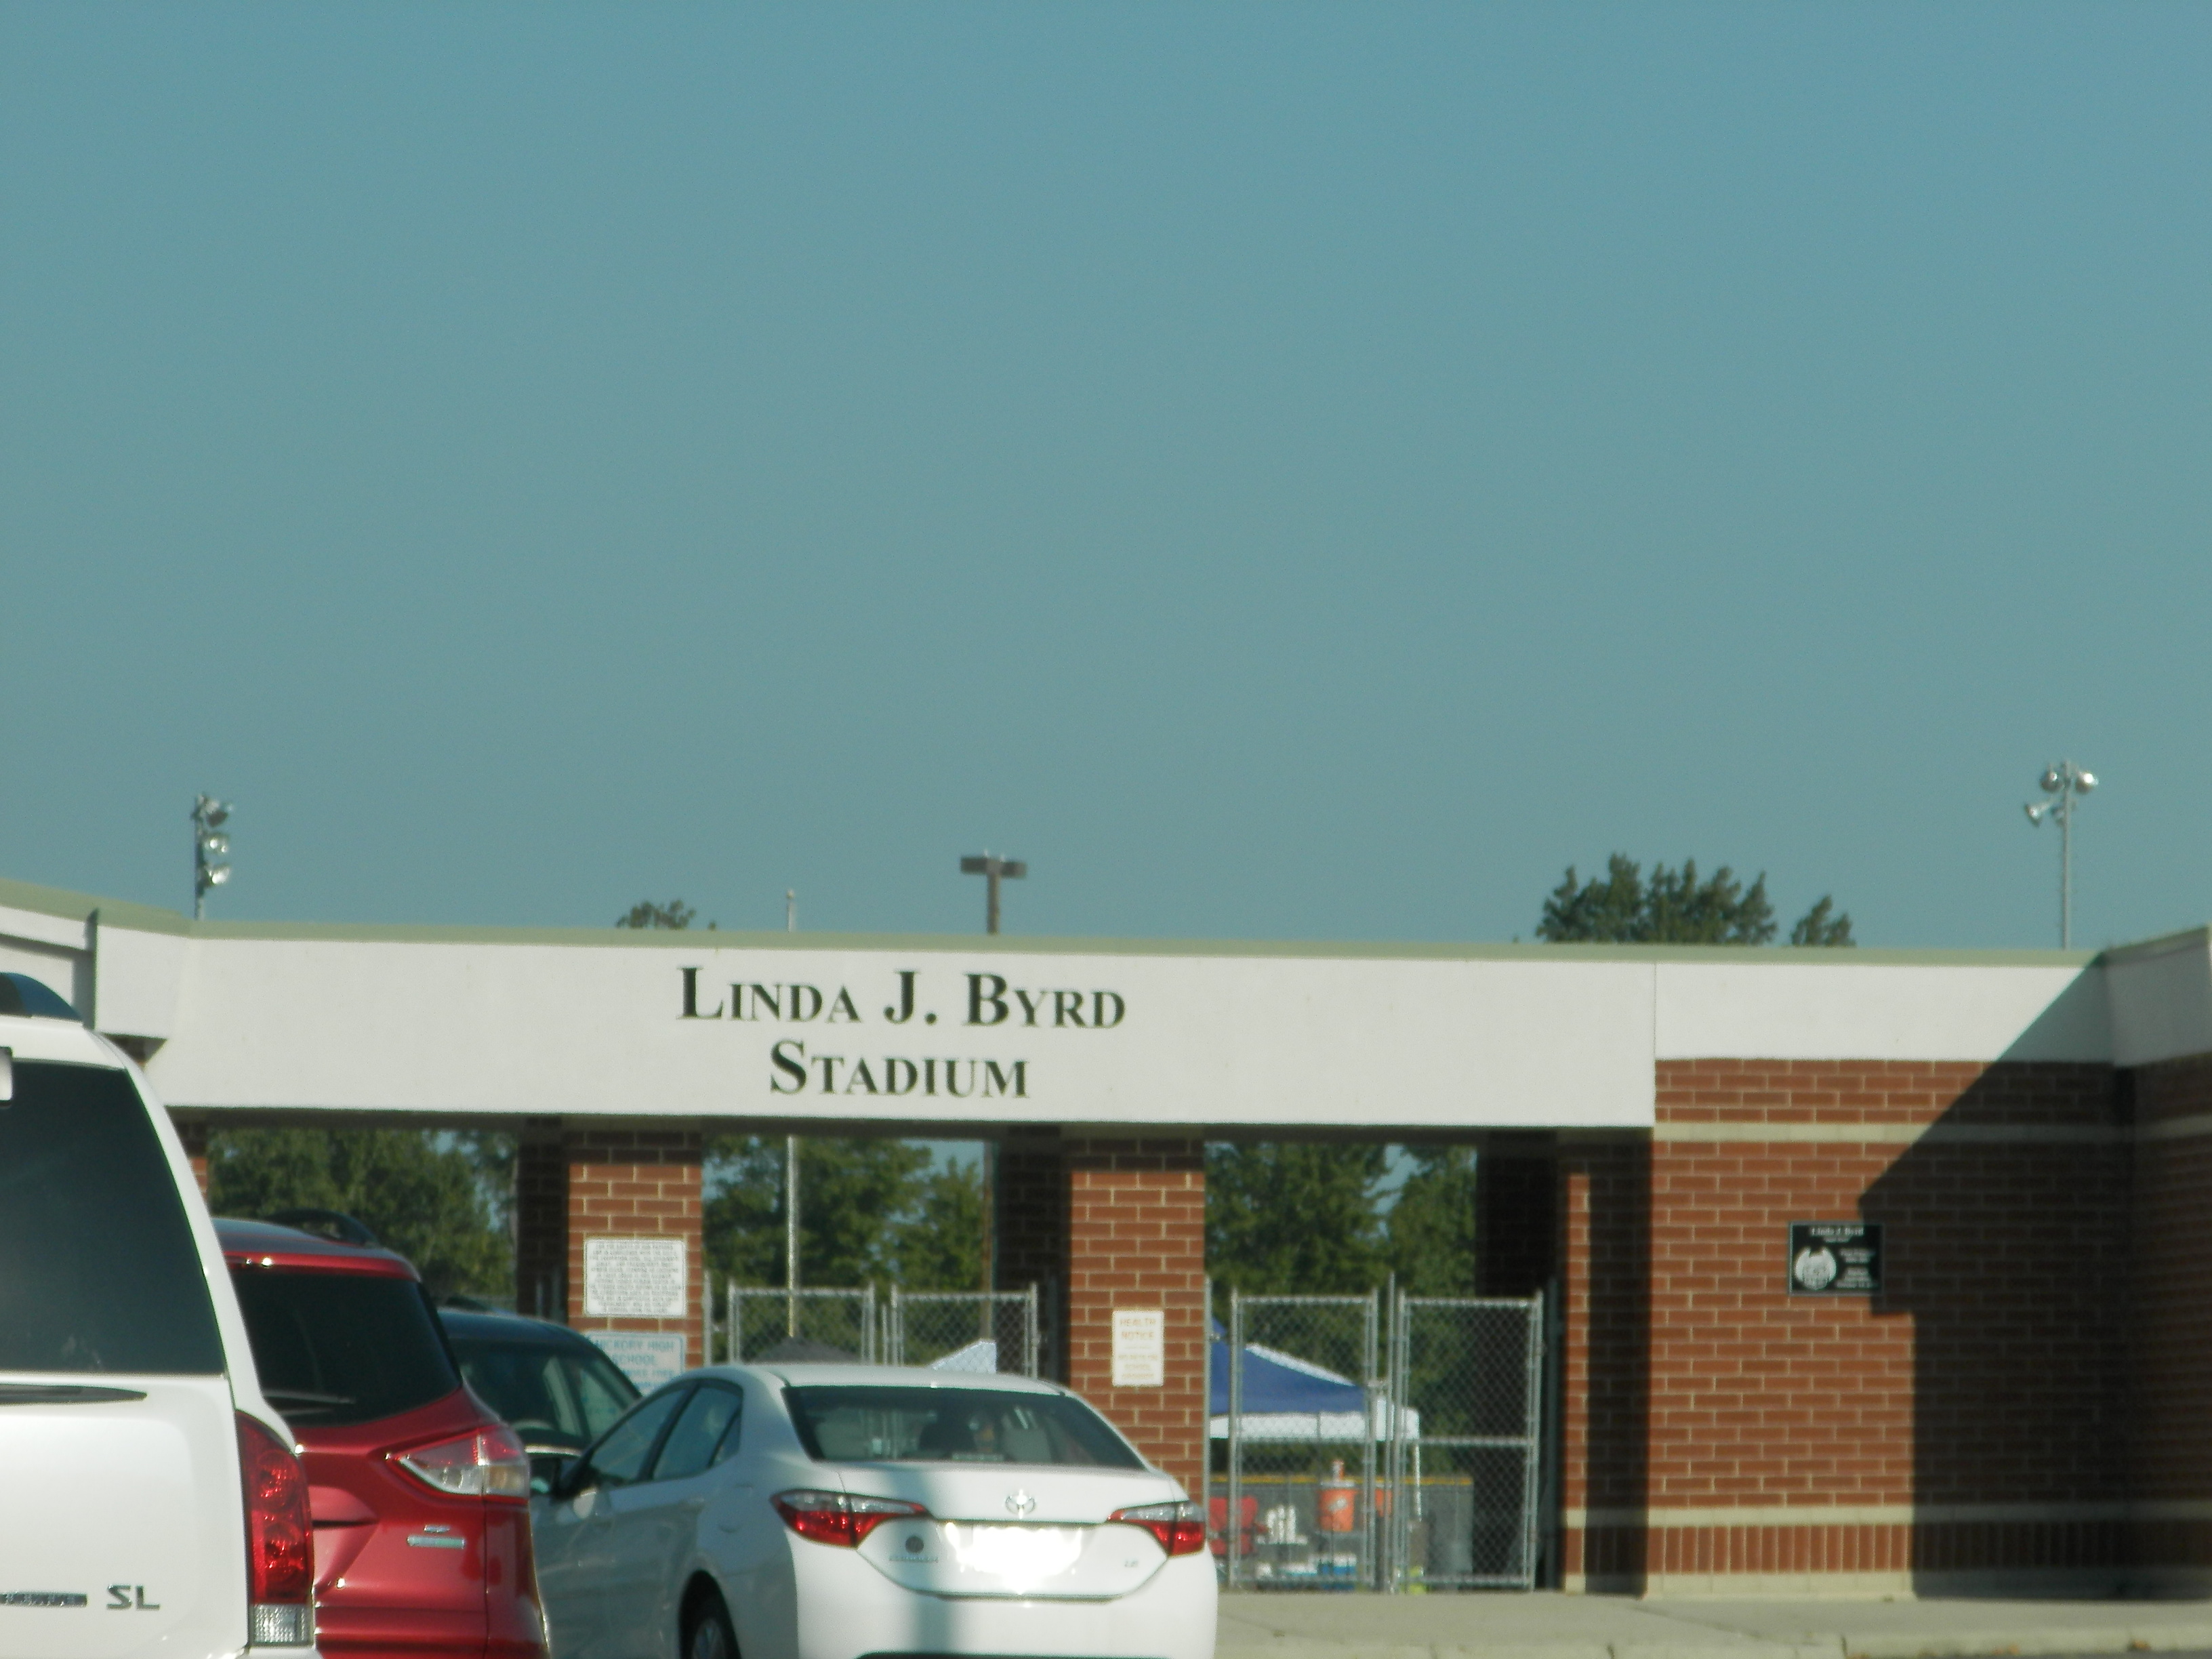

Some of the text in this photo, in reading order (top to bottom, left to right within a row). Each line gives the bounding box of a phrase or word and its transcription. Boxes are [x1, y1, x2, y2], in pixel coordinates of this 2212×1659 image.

[678, 966, 1126, 1028] LINDA J. BYRD
[769, 1038, 1029, 1098] STADIUM
[106, 1584, 161, 1611] SL
